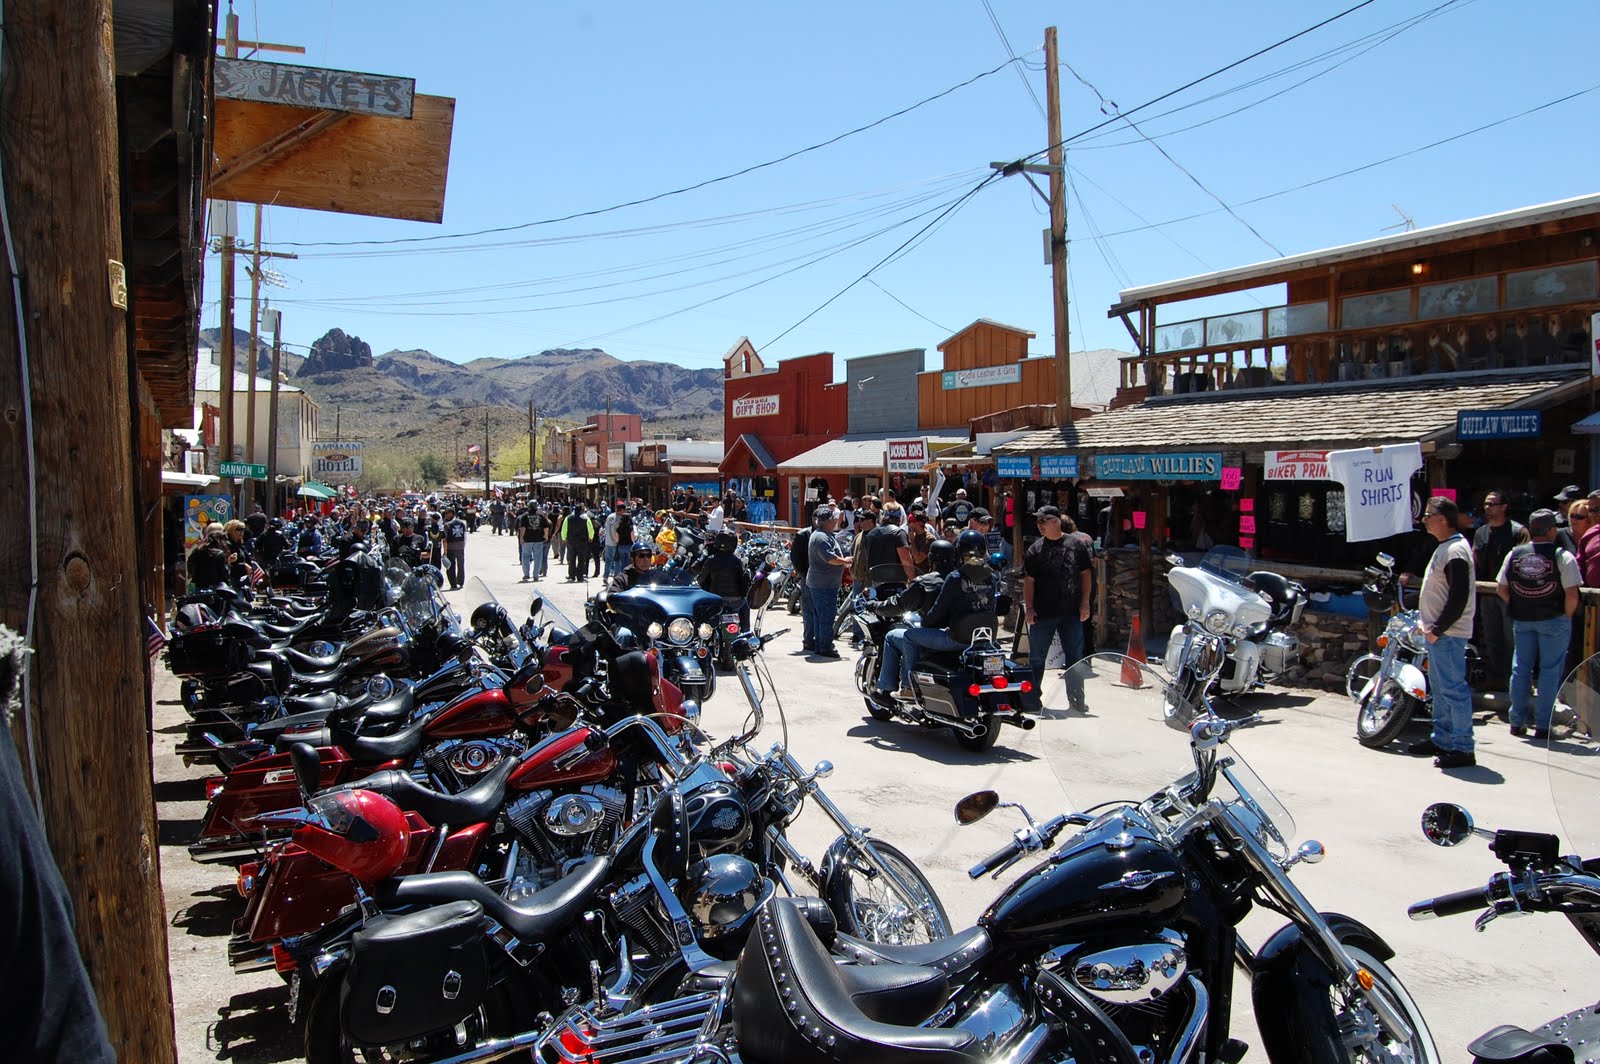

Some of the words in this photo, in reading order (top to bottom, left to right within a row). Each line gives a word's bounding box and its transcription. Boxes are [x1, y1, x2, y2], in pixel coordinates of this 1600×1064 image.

[258, 69, 401, 113] JACKETS
[735, 405, 753, 416] GIFT
[756, 402, 776, 415] SHOP
[1462, 417, 1499, 434] OUTLAW
[1500, 415, 1537, 433] WILLIE'S
[220, 464, 252, 476] BANNON
[317, 459, 358, 472] HOTEL
[1103, 456, 1145, 476] OUTLAW
[1268, 464, 1297, 478] BIKER
[1302, 463, 1330, 478] PRIN
[1226, 470, 1237, 480] 66
[1365, 467, 1393, 483] RUN
[1360, 484, 1404, 506] SHIRTS
[215, 503, 226, 514] 66
